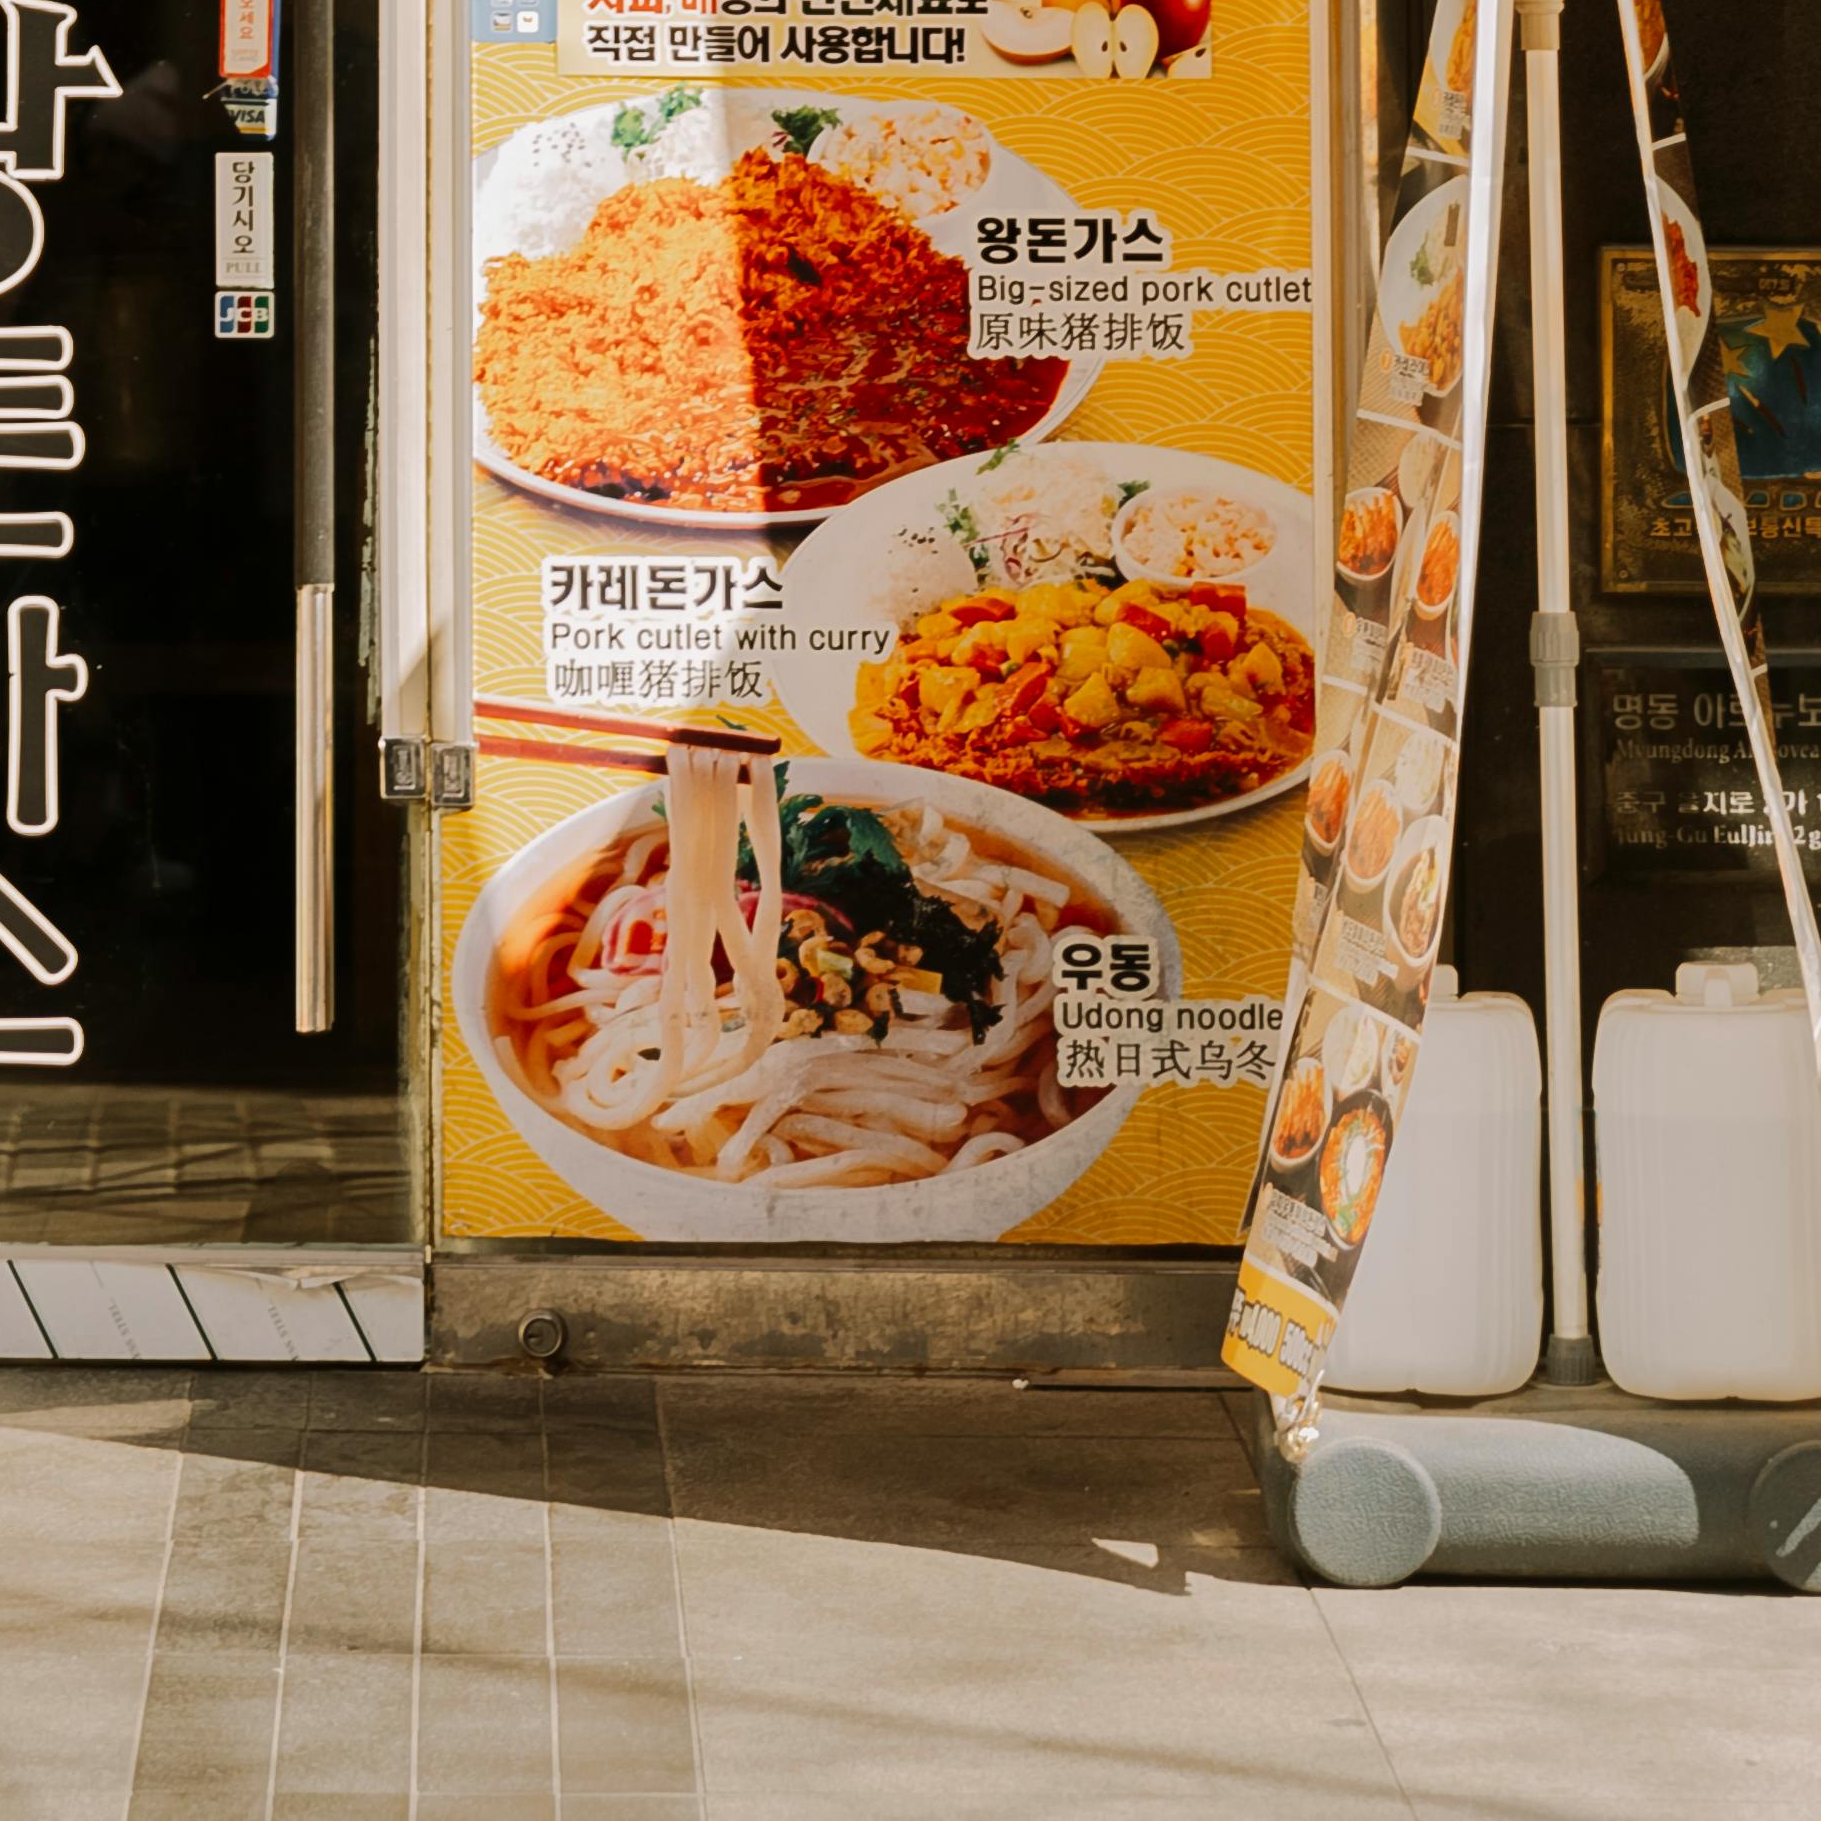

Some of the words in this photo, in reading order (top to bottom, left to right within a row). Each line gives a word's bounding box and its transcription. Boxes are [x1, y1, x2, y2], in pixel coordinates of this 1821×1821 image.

[585, 24, 657, 64] 직접
[669, 24, 770, 64] 만들어
[781, 24, 966, 65] 사용합니다!
[232, 161, 256, 254] 당기시오
[976, 215, 1164, 264] 왕돈가스
[978, 275, 1129, 306] Big-sized
[1142, 275, 1214, 306] pork
[1225, 275, 1313, 303] cutlet
[976, 311, 1185, 351] 原味猪排饭
[550, 564, 784, 611] 카레돈가스
[551, 622, 625, 650] Pork
[636, 622, 722, 650] cutlet
[735, 623, 797, 650] with
[809, 627, 891, 654] curry
[554, 659, 764, 699] 咖喱猪排饭
[1613, 693, 1680, 731] 명동
[1061, 943, 1152, 992] 우동
[1062, 1001, 1163, 1033] Udong
